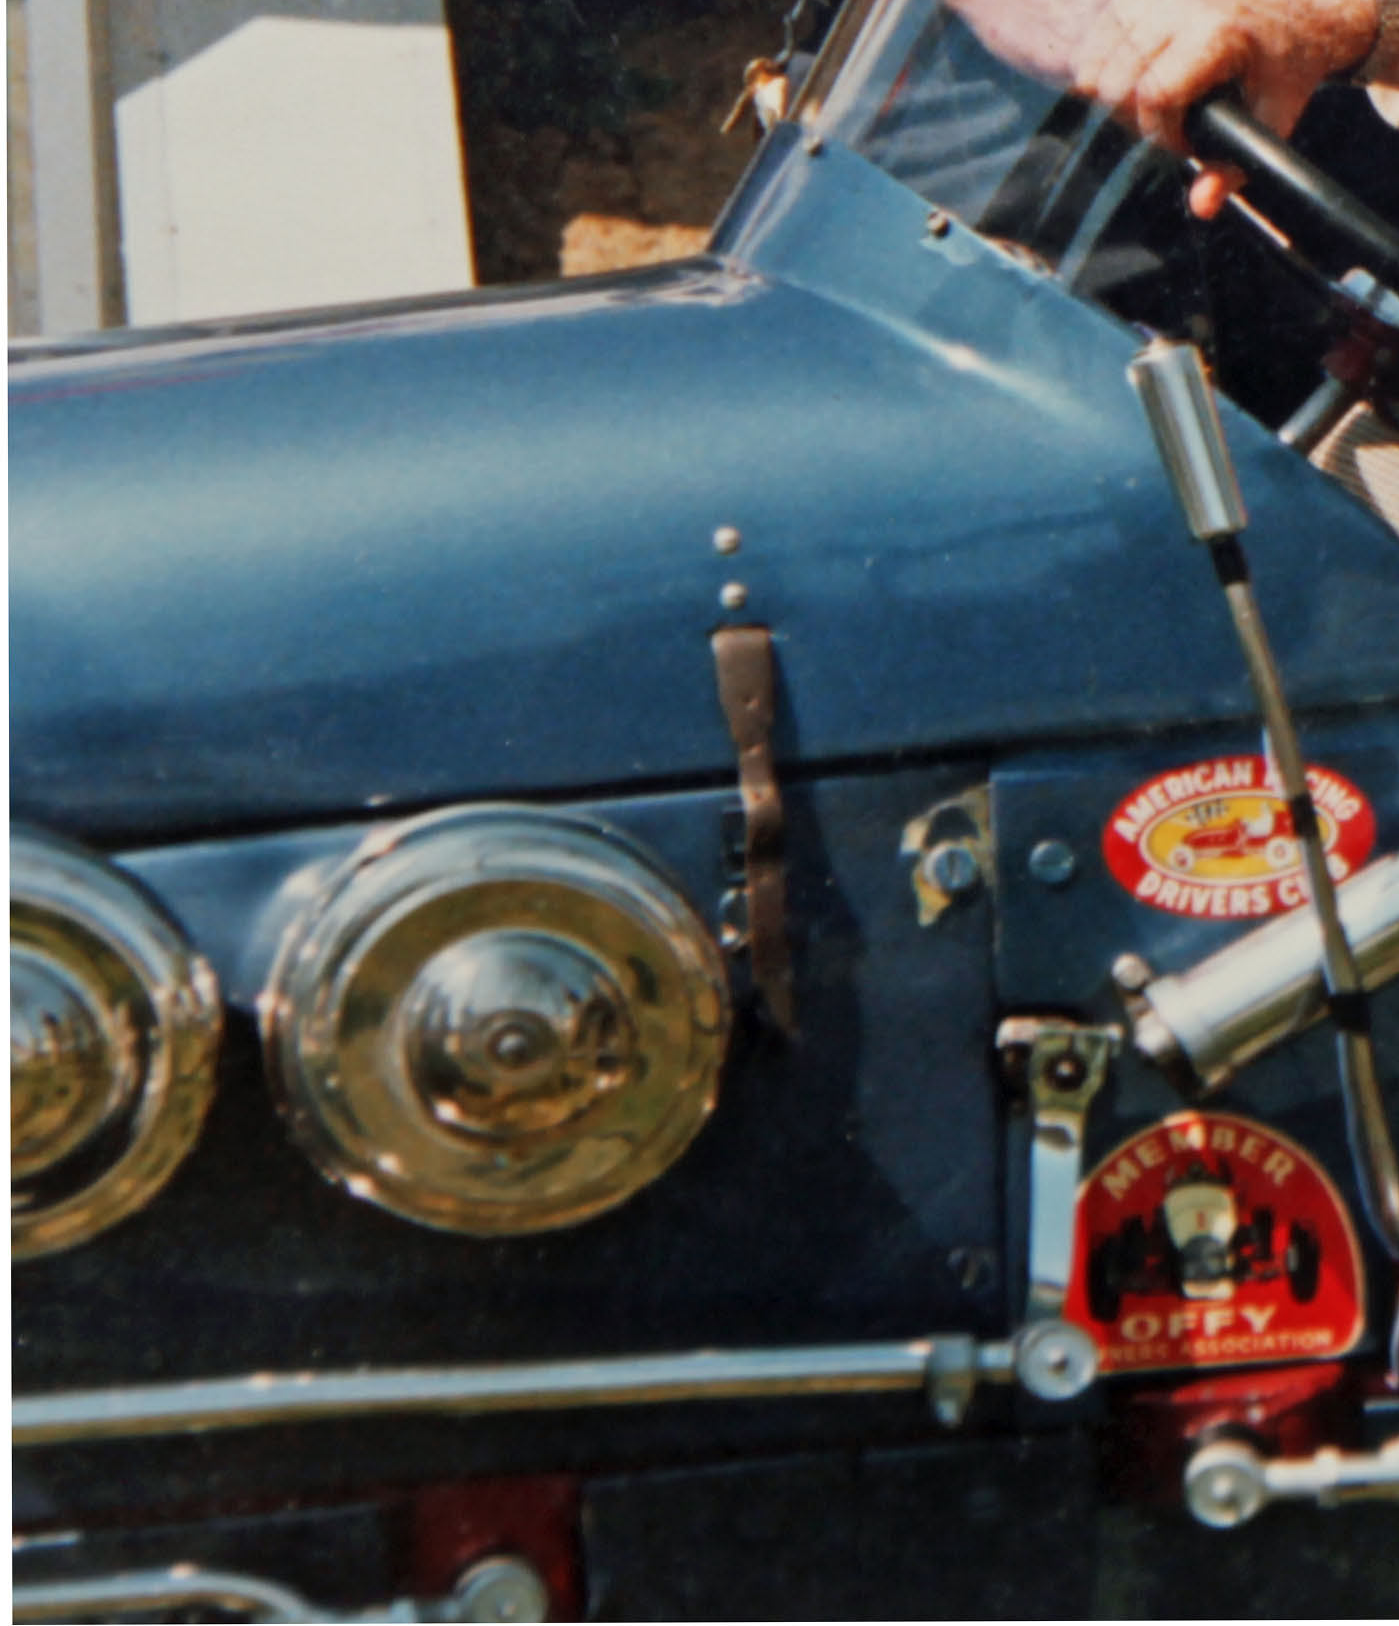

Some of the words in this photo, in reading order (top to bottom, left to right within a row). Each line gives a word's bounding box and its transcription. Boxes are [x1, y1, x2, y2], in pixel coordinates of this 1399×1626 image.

[1113, 760, 1254, 844] AMERICAN
[1264, 761, 1361, 822] CING
[1136, 870, 1272, 917] DRIVERS
[1102, 1124, 1295, 1201] MEMBER
[1120, 1304, 1277, 1343] OFFY
[1179, 1328, 1334, 1360] ASSOCIATION
